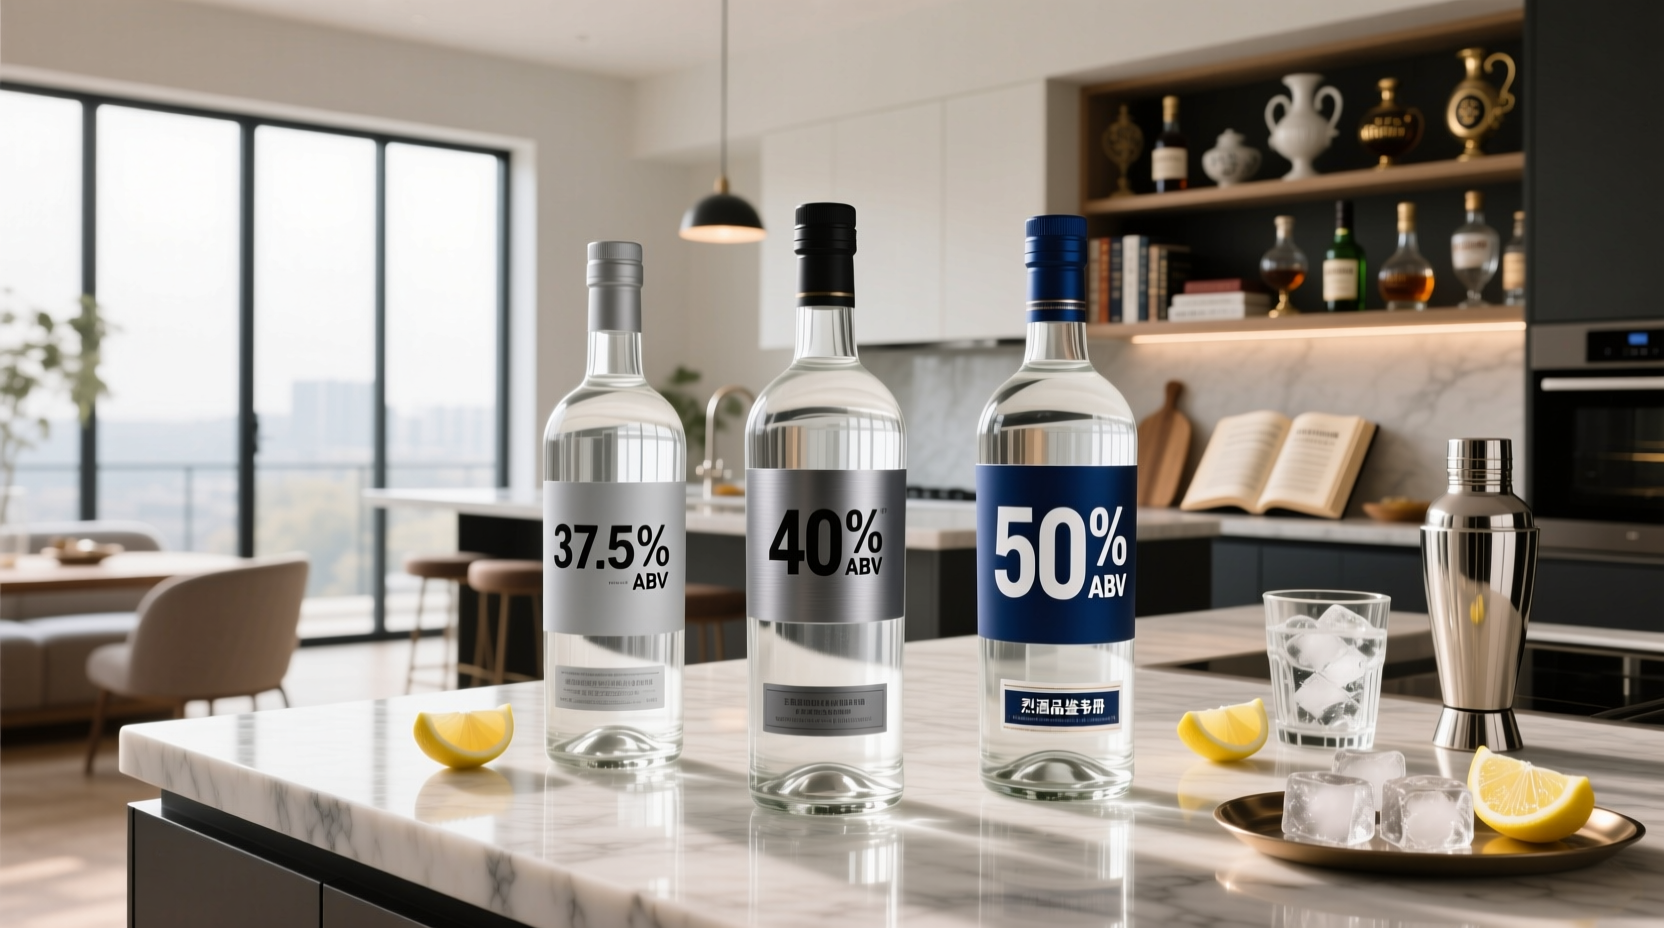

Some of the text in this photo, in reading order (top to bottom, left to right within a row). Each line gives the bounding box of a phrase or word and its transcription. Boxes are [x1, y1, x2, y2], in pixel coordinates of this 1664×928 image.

[554, 523, 670, 570] 37.5%
[769, 508, 883, 577] 40%
[994, 505, 1128, 601] 50%
[632, 571, 669, 591] ABV
[845, 556, 883, 576] ABV
[1087, 572, 1127, 599] ABV
